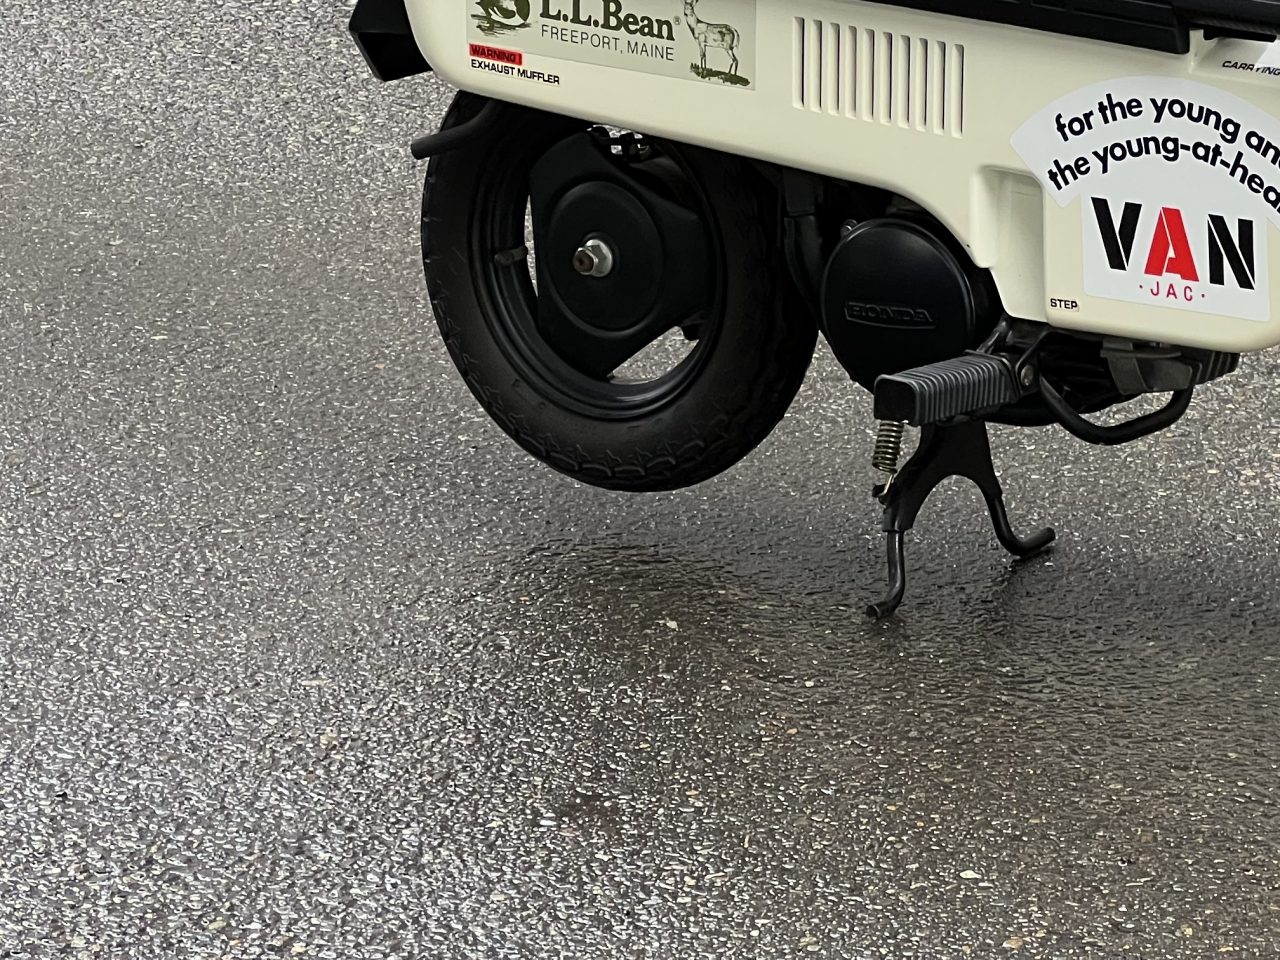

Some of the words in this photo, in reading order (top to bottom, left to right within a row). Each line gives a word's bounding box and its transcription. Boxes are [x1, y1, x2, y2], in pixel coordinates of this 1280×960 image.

[470, 44, 516, 63] WARNING
[541, 24, 623, 54] FREEPORT,
[626, 40, 675, 61] MAINE
[470, 58, 516, 76] EXHAUST
[517, 67, 560, 86] MUFFLER
[1055, 112, 1094, 142] for
[1098, 93, 1143, 125] the
[1149, 97, 1242, 144] young
[1047, 156, 1091, 191] the
[1090, 196, 1256, 290] VAN
[848, 302, 934, 323] HONDA
[1049, 297, 1079, 311] STEP
